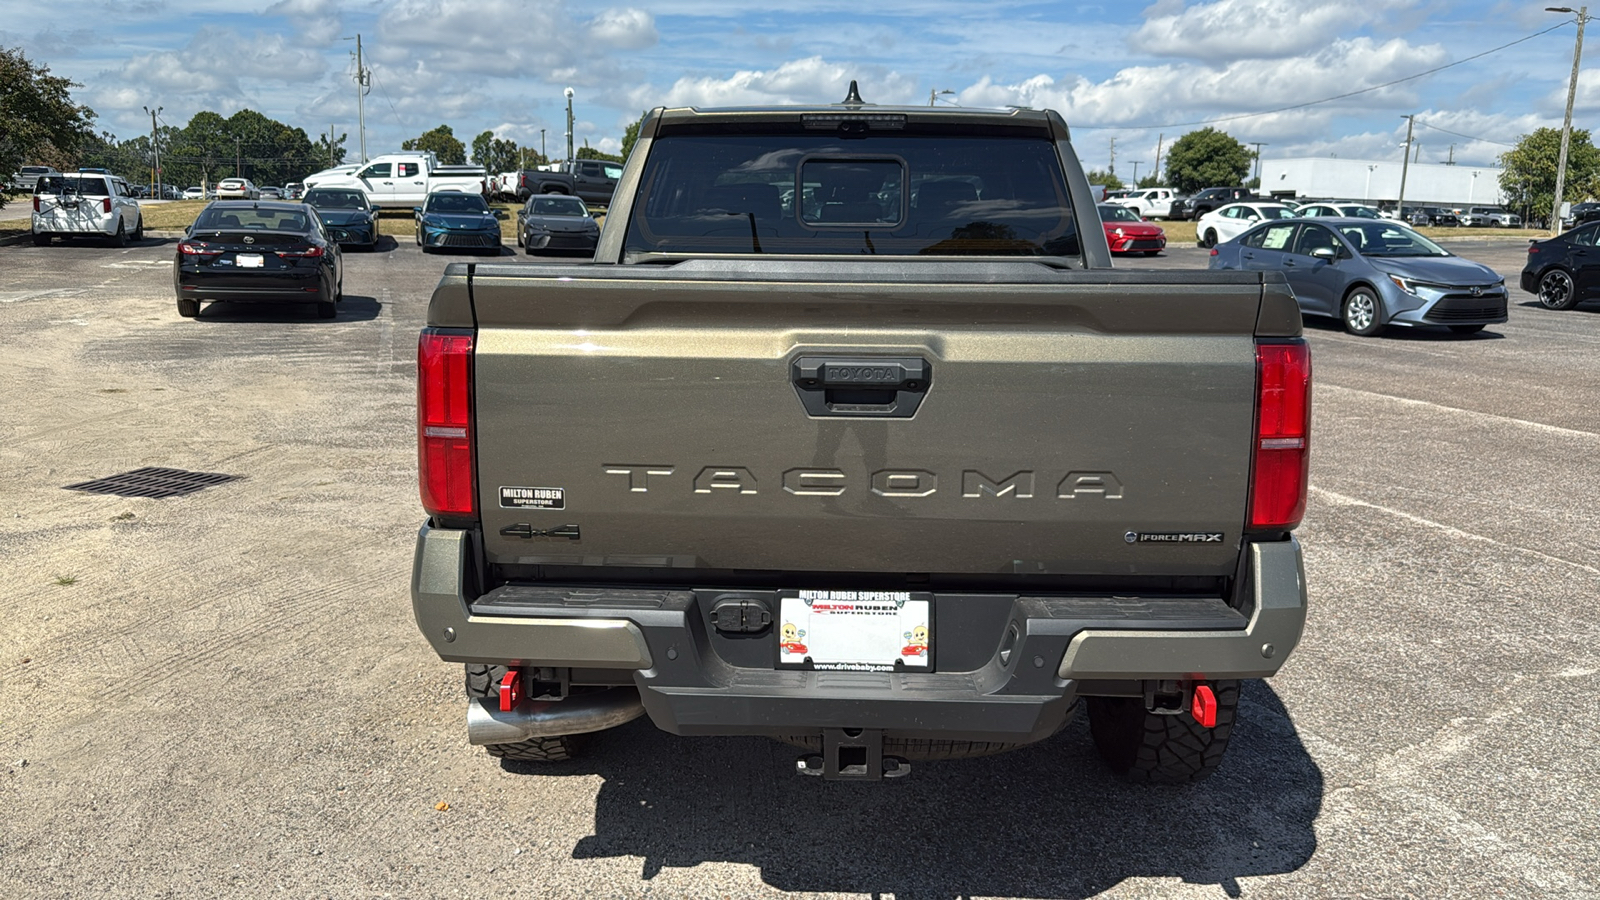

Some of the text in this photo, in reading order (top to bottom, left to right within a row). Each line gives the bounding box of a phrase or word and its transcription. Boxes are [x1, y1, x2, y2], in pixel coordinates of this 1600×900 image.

[828, 367, 895, 380] TOYOTA
[602, 463, 1124, 499] TACOMA
[503, 489, 562, 499] MILTON RUBEN
[799, 590, 910, 601] MILTON RUBEN SUPERSTORE
[813, 662, 894, 672] www.drivebaby.com
